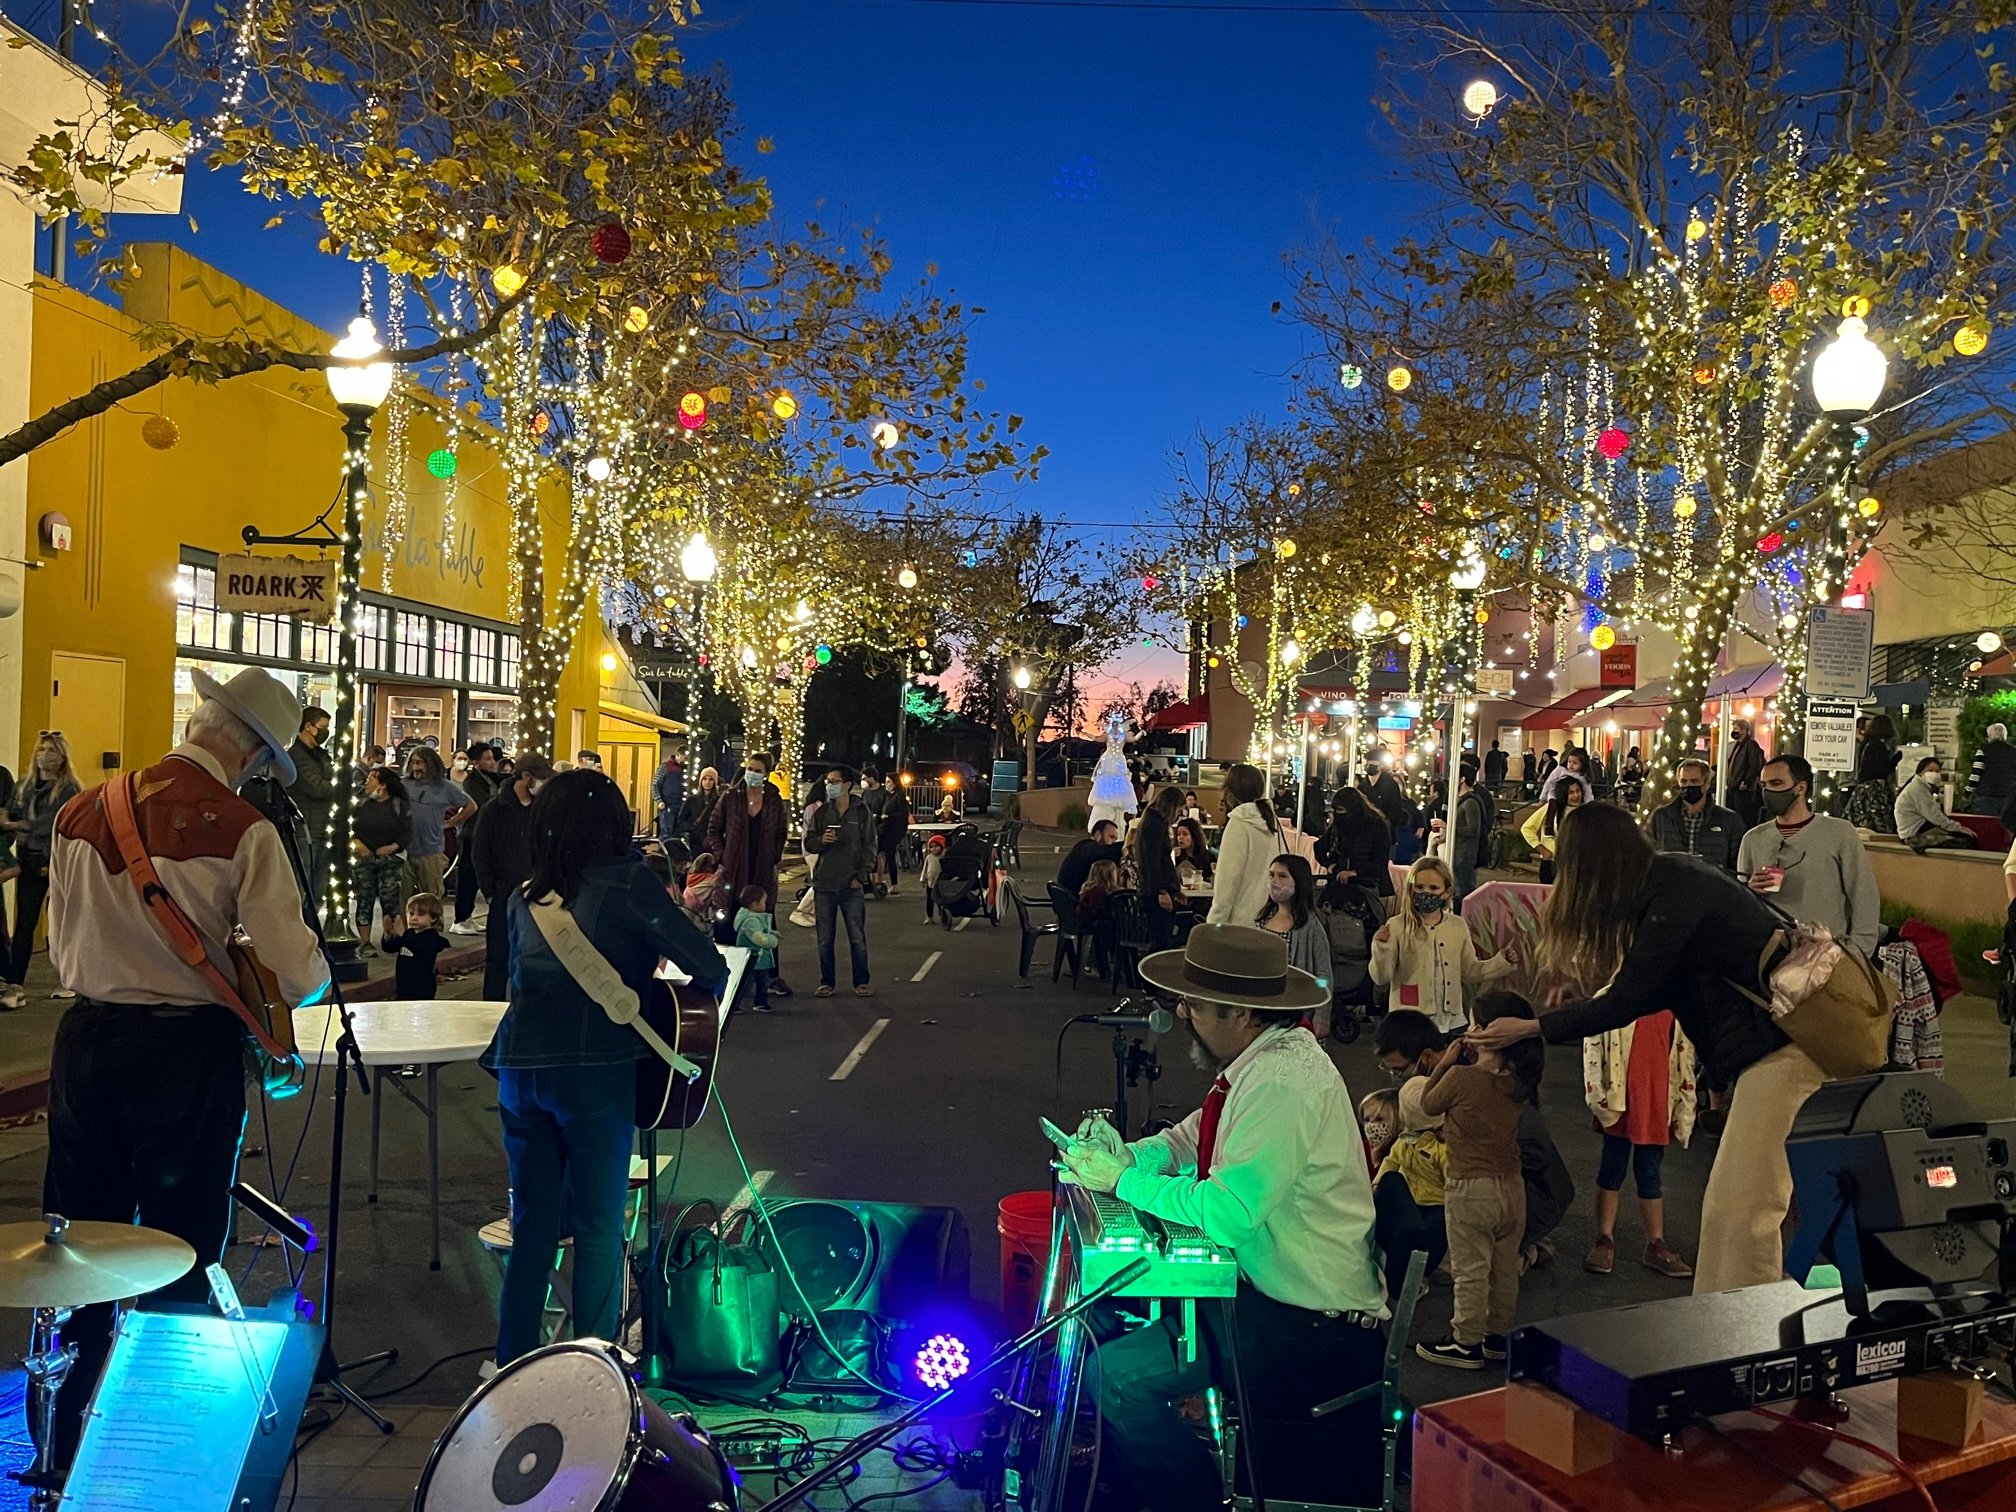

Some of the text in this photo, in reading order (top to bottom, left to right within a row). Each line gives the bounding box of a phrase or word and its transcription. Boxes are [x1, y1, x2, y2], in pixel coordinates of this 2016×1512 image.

[228, 574, 297, 597] ROARK
[638, 665, 688, 679] Sur la table
[1320, 691, 1347, 700] VINO
[1812, 706, 1852, 714] ATTENTION
[1824, 735, 1837, 743] YOUR
[1837, 735, 1848, 743] CAR
[1856, 1340, 1906, 1363] lexicon
